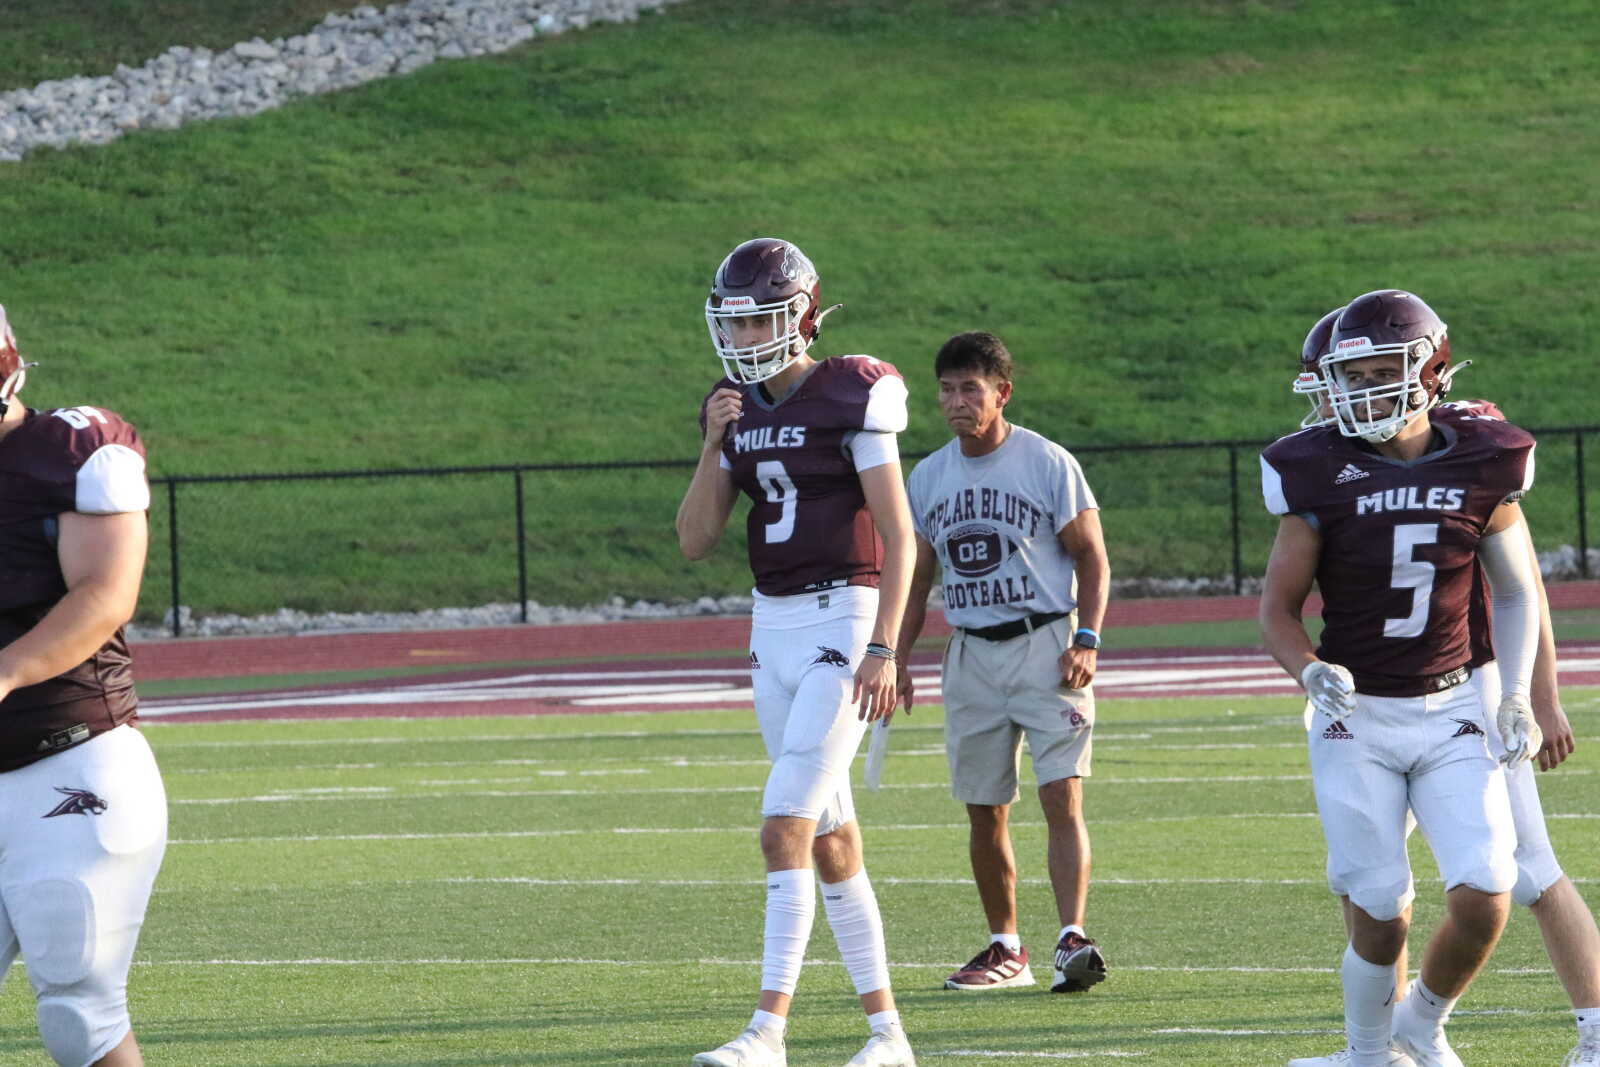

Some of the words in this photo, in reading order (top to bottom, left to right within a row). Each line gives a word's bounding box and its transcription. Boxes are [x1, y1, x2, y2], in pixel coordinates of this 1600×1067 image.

[735, 426, 806, 453] MULES
[1335, 471, 1370, 485] adidas
[756, 460, 797, 544] 9
[926, 488, 976, 543] OPLAR
[981, 487, 1040, 538] BLUFF
[1357, 487, 1464, 515] MULES
[958, 540, 988, 563] 02
[943, 575, 1035, 610] OOTBALL
[1383, 523, 1439, 637] 5
[1323, 732, 1354, 740] adidas
